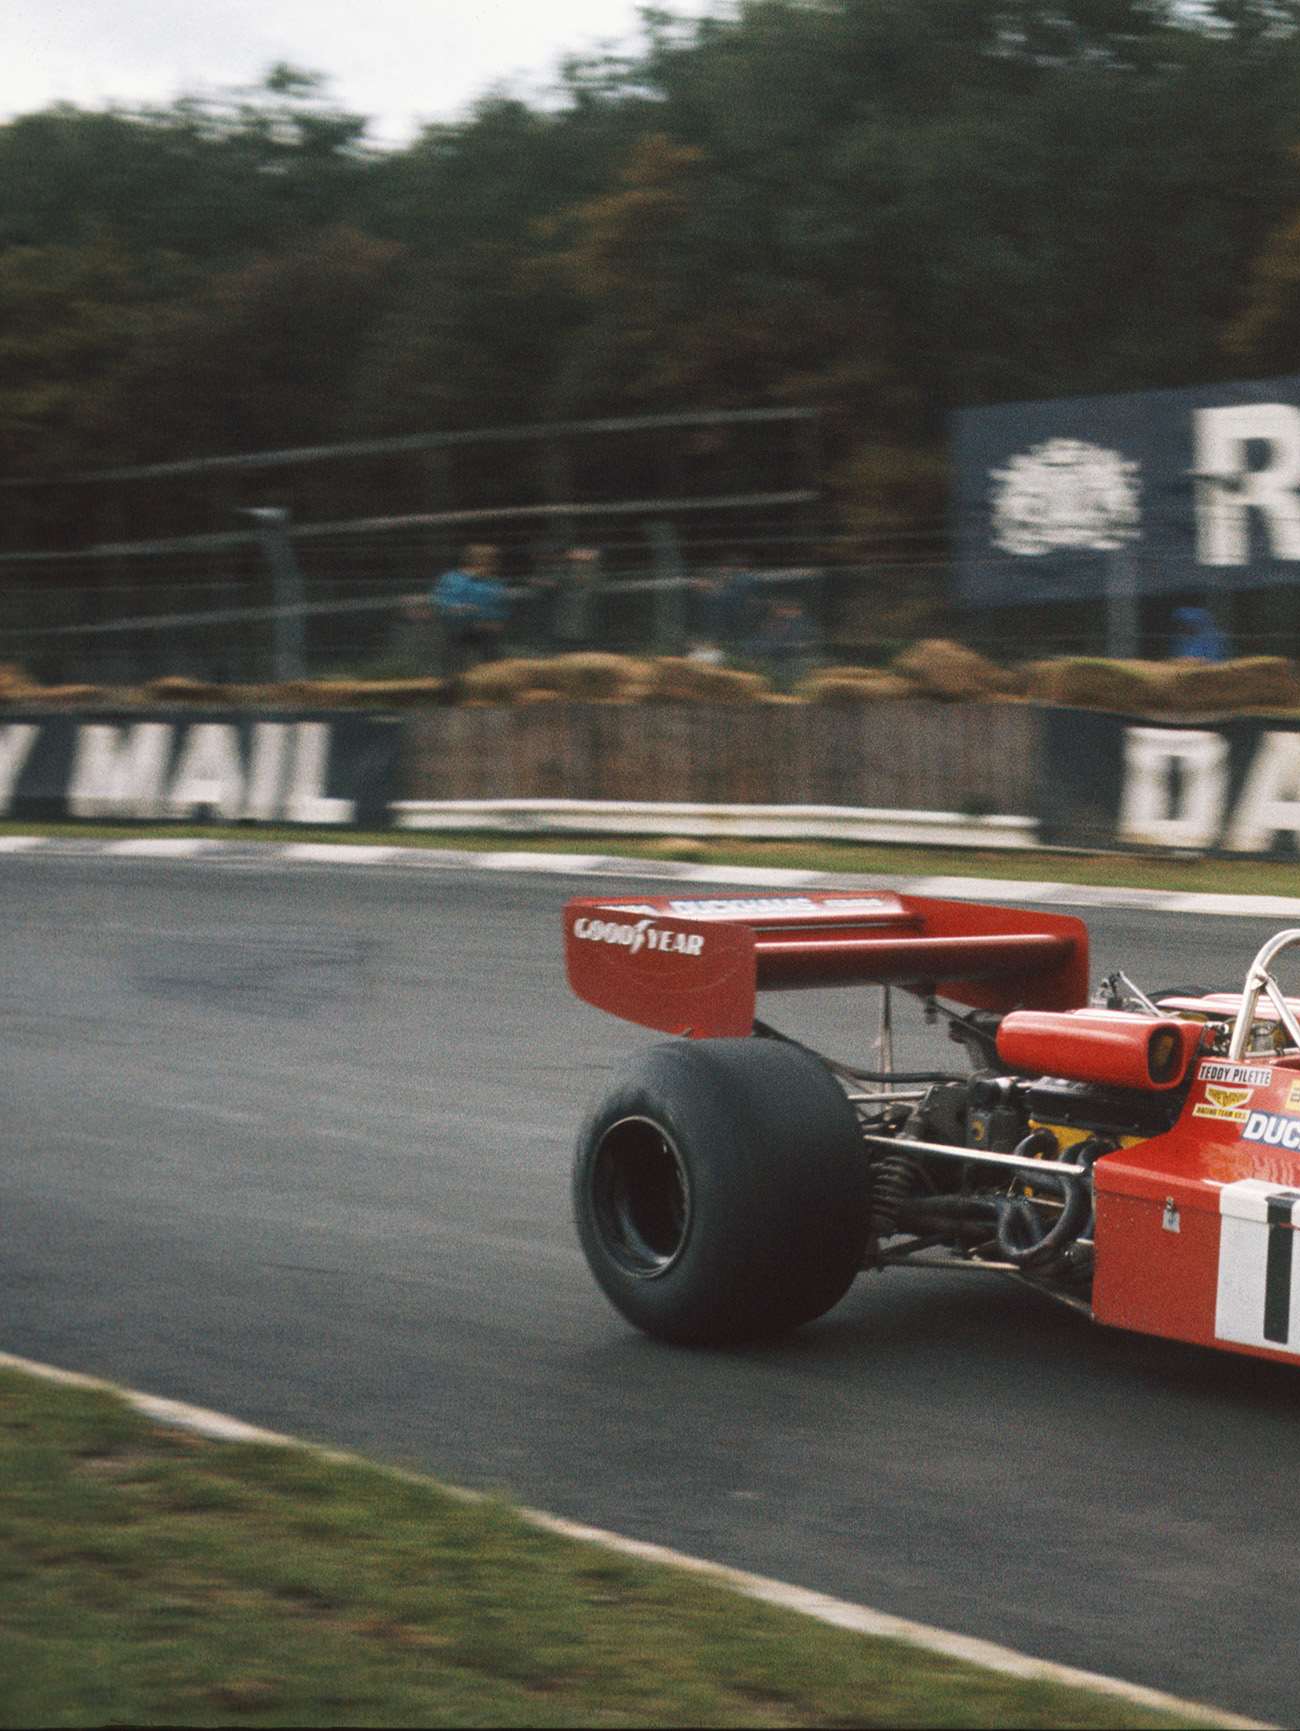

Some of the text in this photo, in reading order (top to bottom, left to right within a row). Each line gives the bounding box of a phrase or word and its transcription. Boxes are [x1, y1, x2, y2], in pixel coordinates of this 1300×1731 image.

[69, 721, 354, 823] MAIL
[1200, 1065, 1271, 1085] TEDDY PILETTE
[1262, 1192, 1300, 1346] 1
